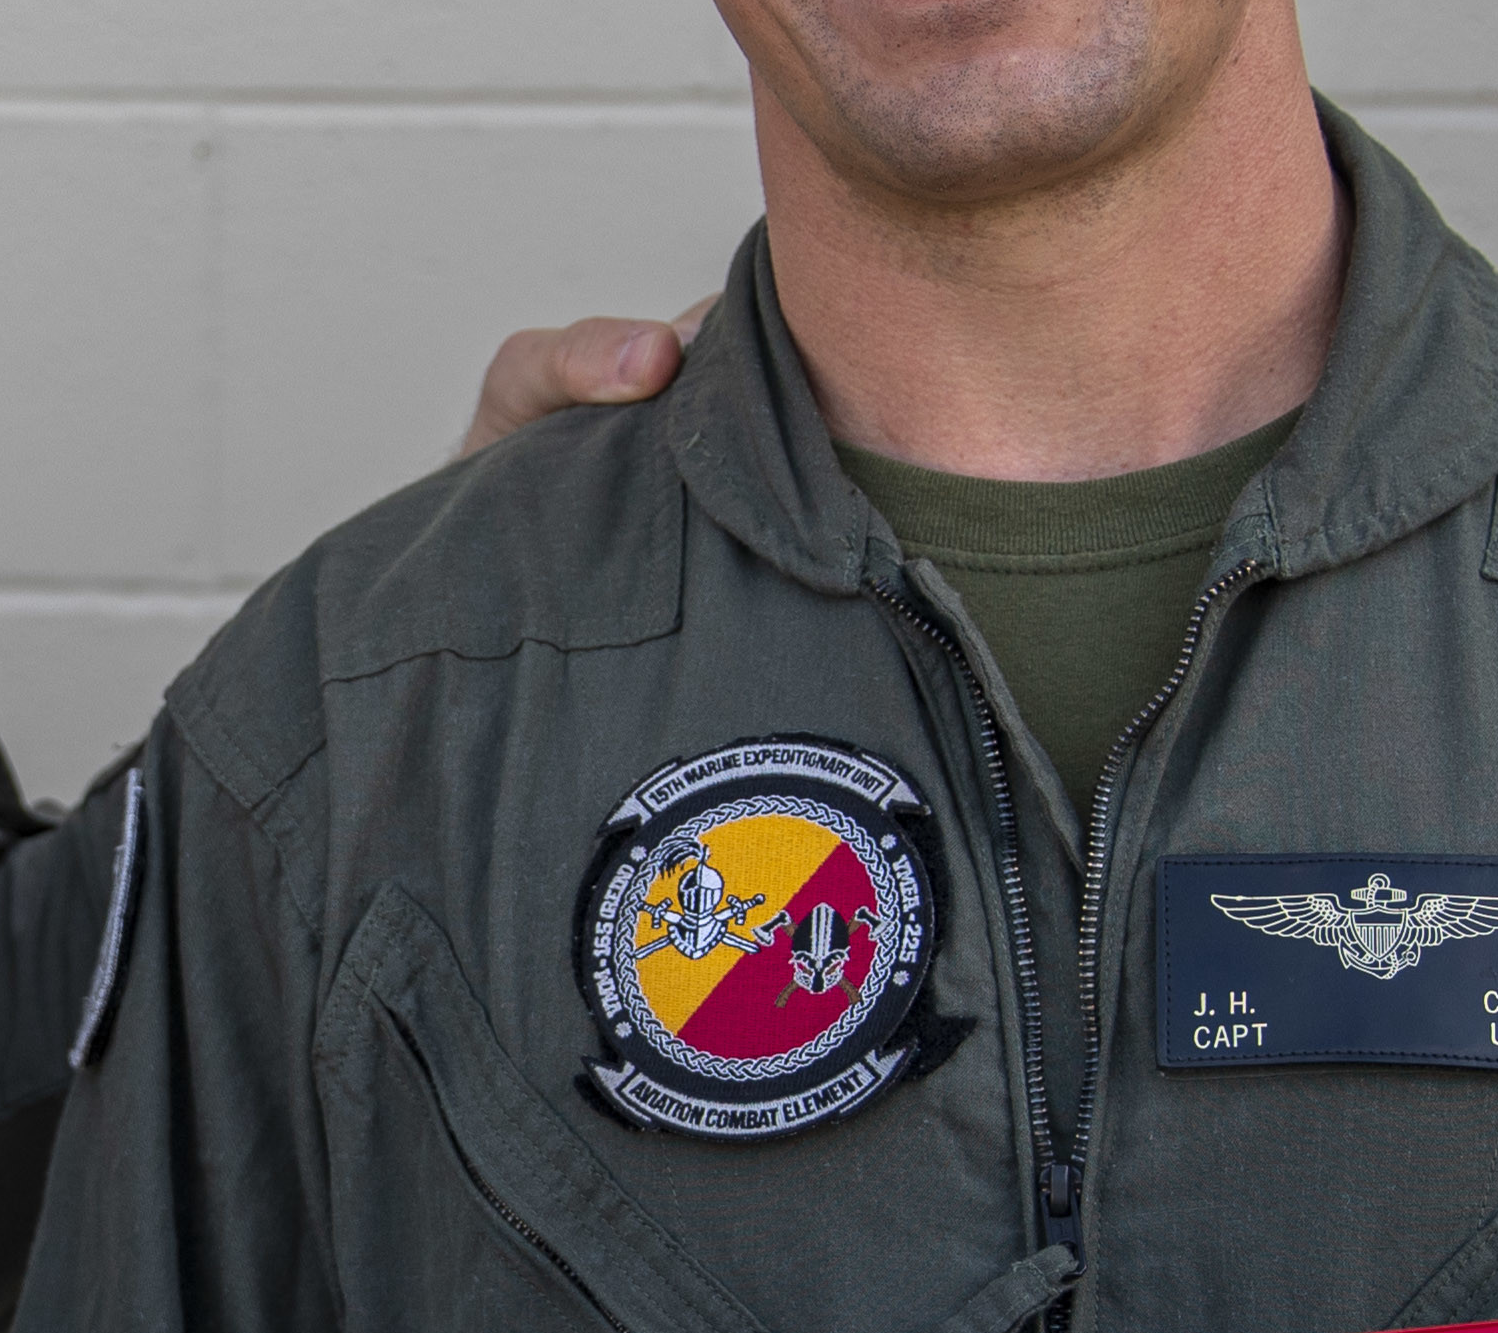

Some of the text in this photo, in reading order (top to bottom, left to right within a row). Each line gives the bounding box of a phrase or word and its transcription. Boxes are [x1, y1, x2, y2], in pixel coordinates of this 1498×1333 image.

[649, 748, 885, 805] 15TH MARINE EXPEDITIONARY UNIT
[1194, 991, 1256, 1016] J. H.
[1193, 1023, 1268, 1049] CAPT
[629, 1072, 864, 1129] AVIATION COMBAT ELEMENT
